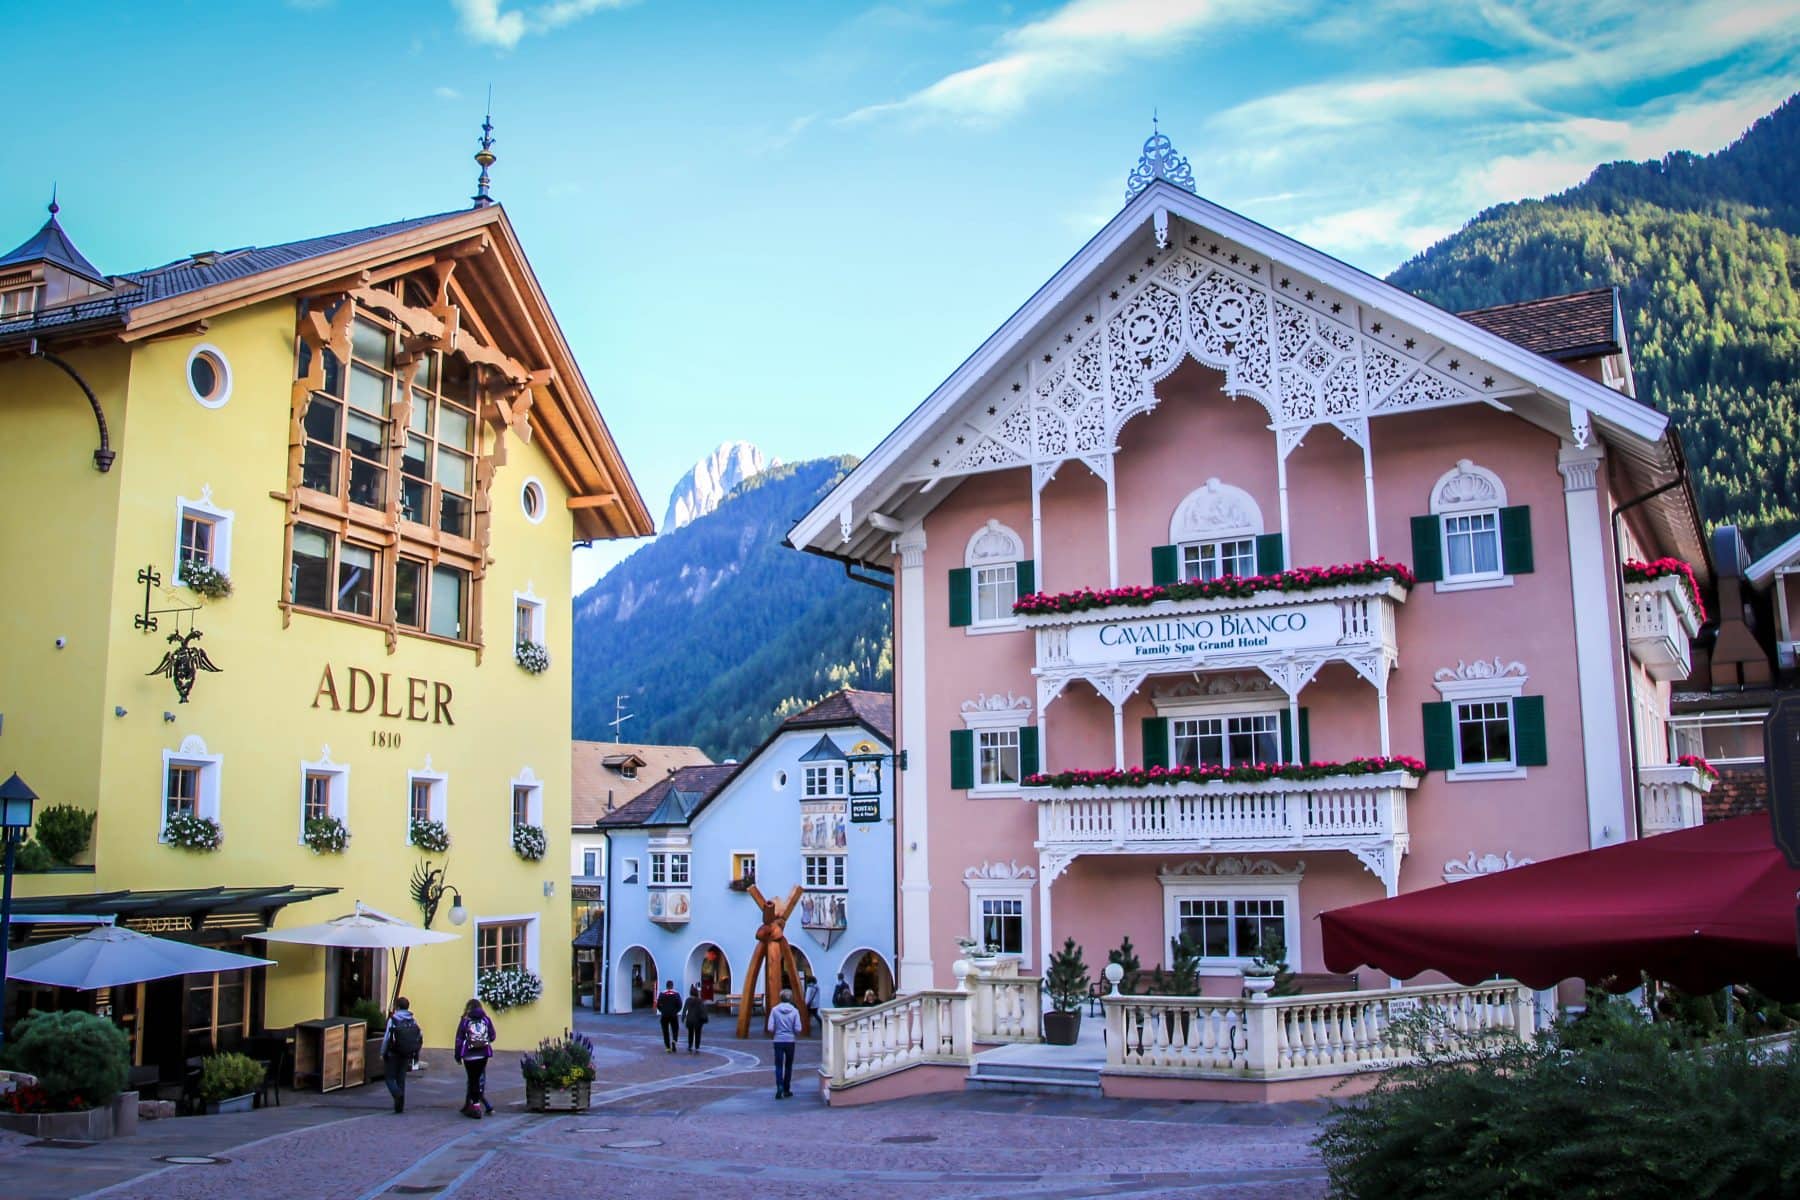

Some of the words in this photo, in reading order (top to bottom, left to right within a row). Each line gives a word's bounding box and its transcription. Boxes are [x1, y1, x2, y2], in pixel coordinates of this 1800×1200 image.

[1135, 644, 1171, 656] Family
[1175, 643, 1195, 654] Spa
[1198, 639, 1234, 651] Grand
[1238, 636, 1268, 648] Hotel
[311, 662, 455, 725] ADLER
[371, 730, 401, 749] 1810
[145, 916, 193, 932] ADLER
